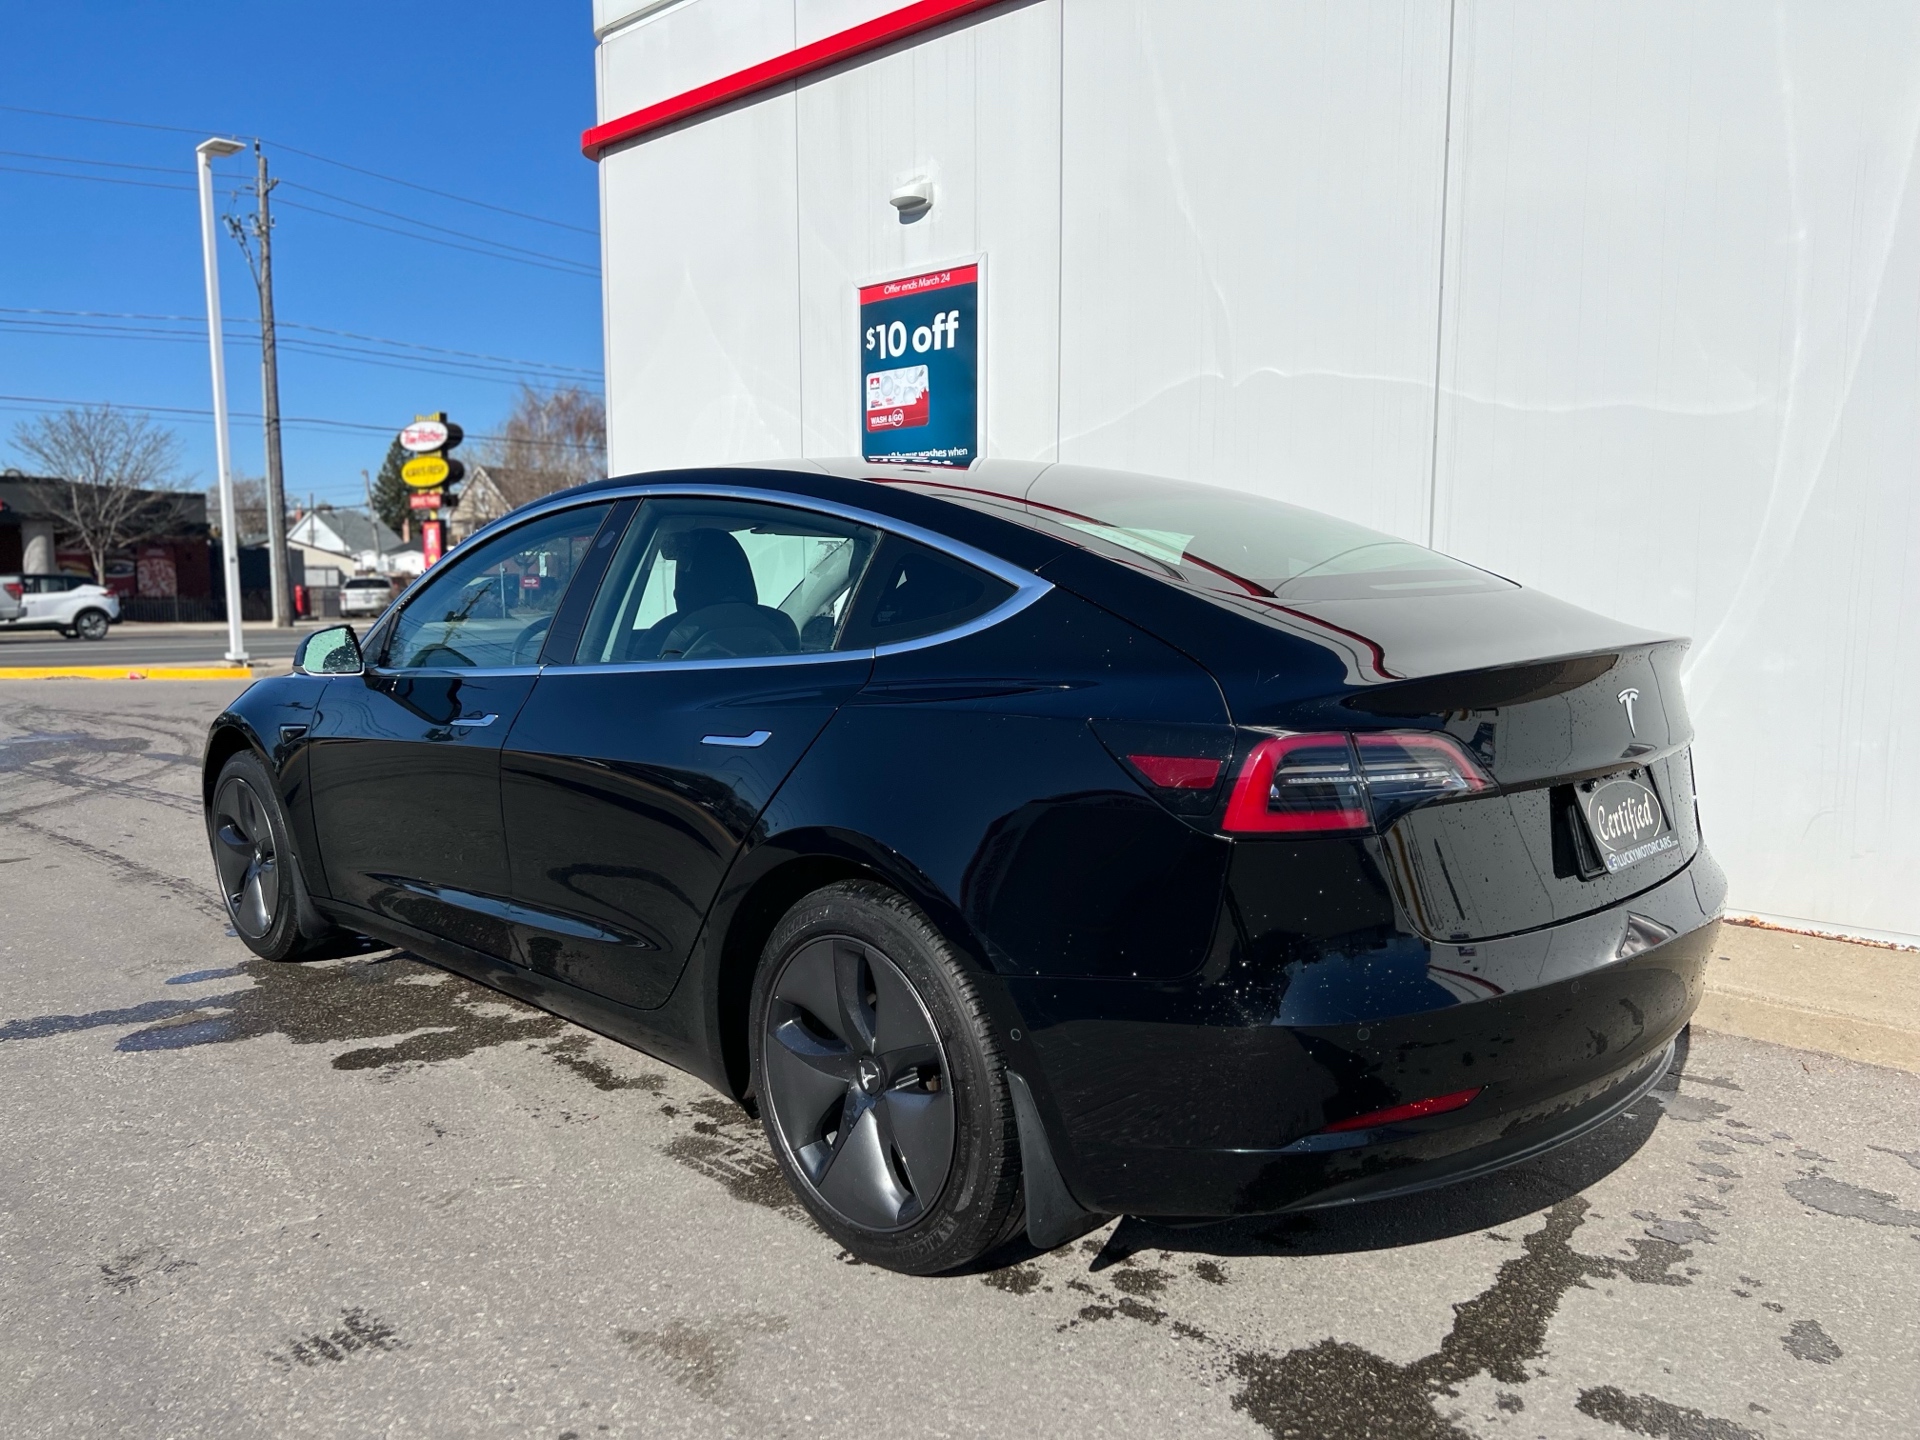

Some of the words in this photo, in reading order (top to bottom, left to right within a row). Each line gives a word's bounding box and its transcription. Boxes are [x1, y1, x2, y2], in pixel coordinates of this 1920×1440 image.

[883, 283, 901, 295] Offer
[901, 280, 918, 291] ends
[918, 275, 940, 287] March
[940, 272, 951, 283] 24
[866, 320, 907, 360] $10
[912, 309, 959, 353] off
[870, 415, 888, 426] WASH
[918, 448, 947, 457] washes
[947, 446, 968, 457] when
[1597, 792, 1653, 841] Certified
